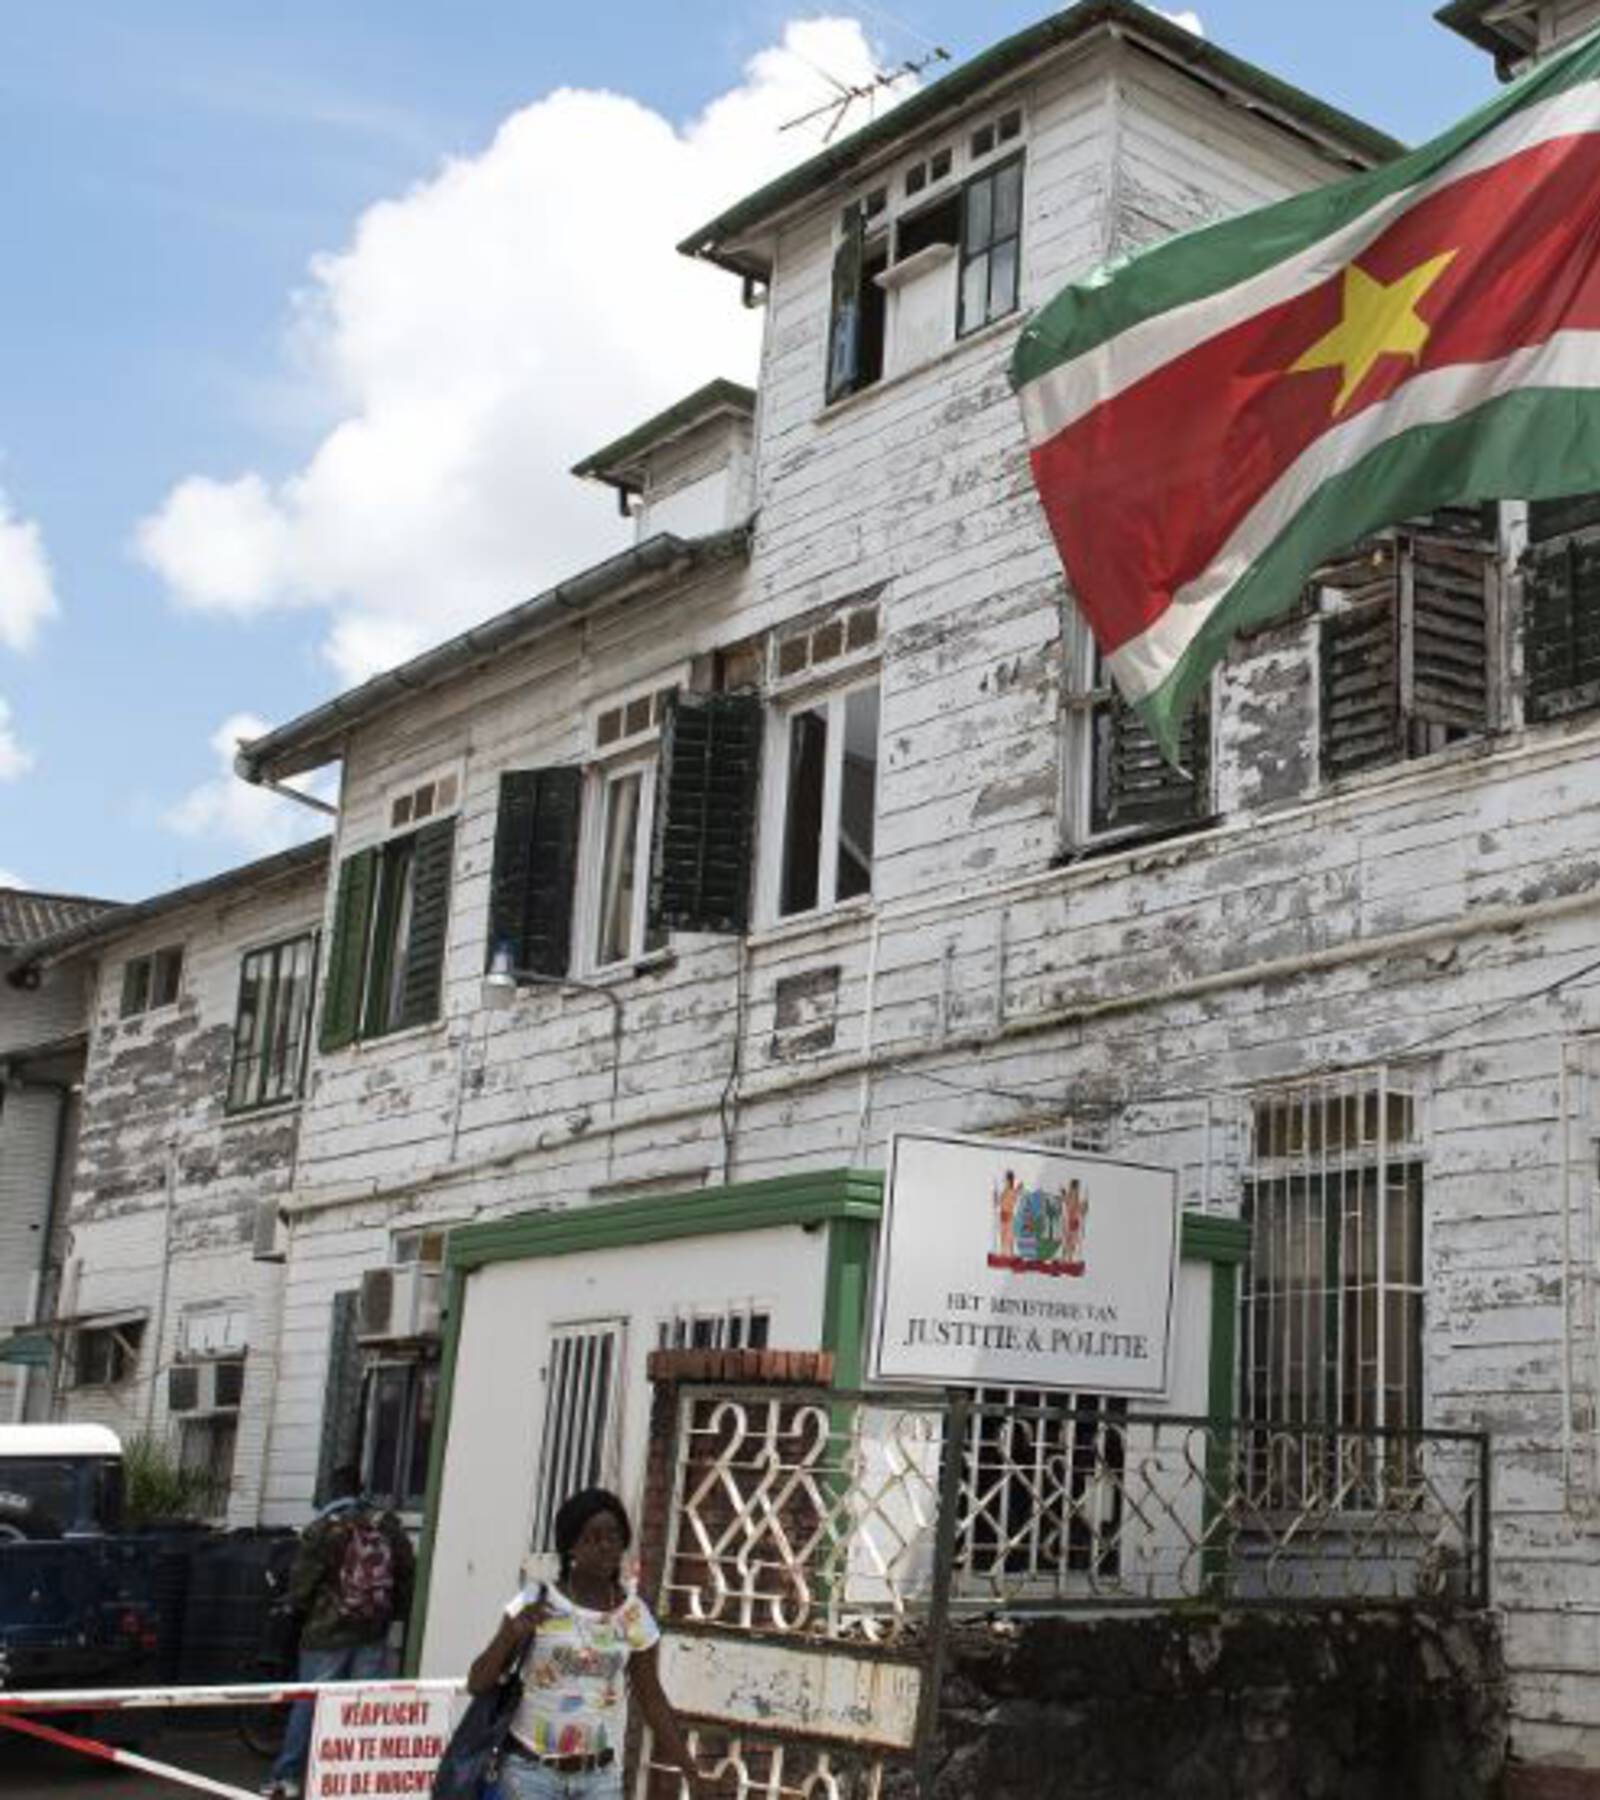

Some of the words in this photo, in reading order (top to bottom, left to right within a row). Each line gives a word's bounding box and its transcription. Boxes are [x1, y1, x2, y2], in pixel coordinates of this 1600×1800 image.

[947, 1292, 984, 1311] HET
[990, 1296, 1082, 1321] MINISTERIE
[904, 1319, 1022, 1351] JUSTITIE
[1026, 1327, 1044, 1352] &
[1051, 1328, 1148, 1359] POLITIE
[341, 1701, 429, 1726] VERPLICHT
[320, 1738, 354, 1760] AAN
[359, 1738, 377, 1760] TE
[379, 1735, 444, 1759] MELDEN
[321, 1773, 346, 1796] BIJ
[350, 1771, 371, 1794] DE
